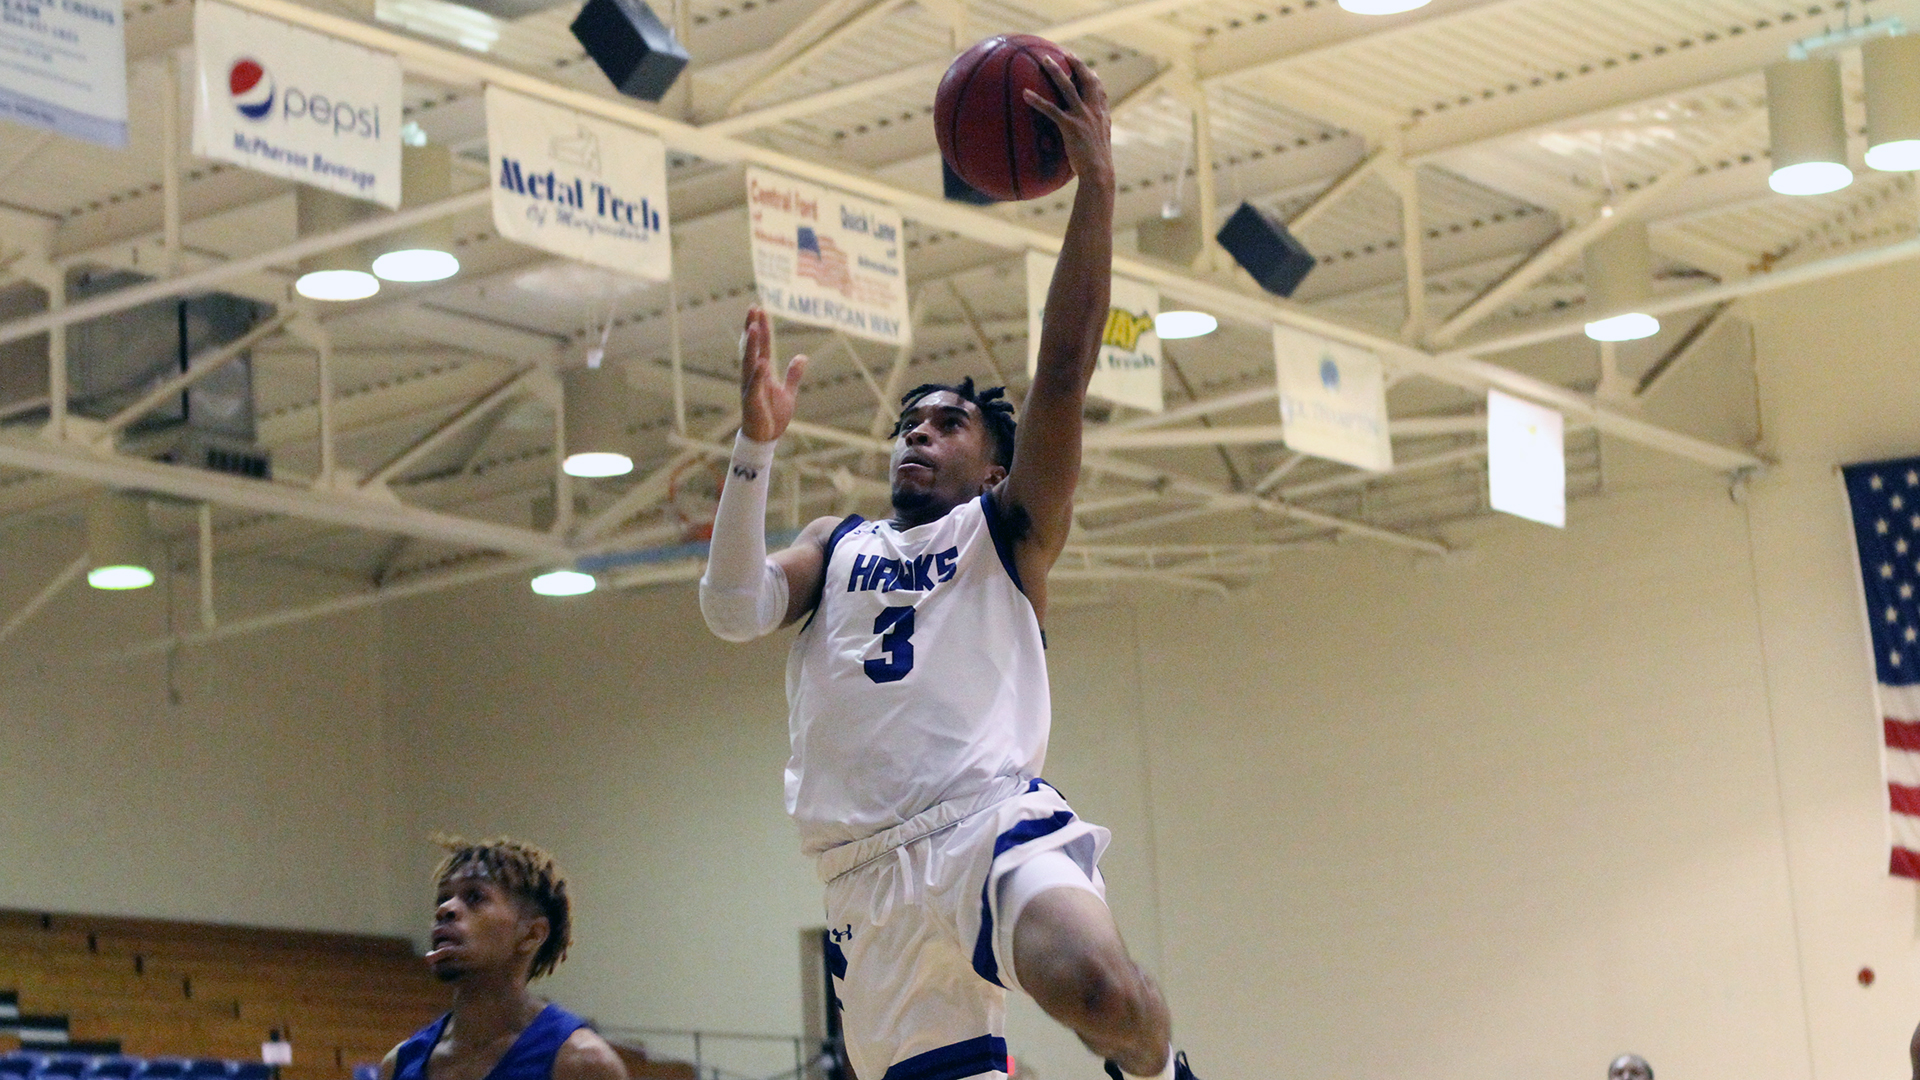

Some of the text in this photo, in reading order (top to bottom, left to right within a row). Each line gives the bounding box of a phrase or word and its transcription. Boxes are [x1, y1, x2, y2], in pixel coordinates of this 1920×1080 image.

[283, 86, 380, 139] pepsi
[500, 155, 584, 210] Metal
[591, 181, 660, 234] Tech
[787, 293, 867, 330] AMERICAN
[870, 314, 901, 337] WAY
[1102, 306, 1156, 353] WAY
[846, 545, 959, 594] HAWKS
[863, 604, 917, 685] 3
